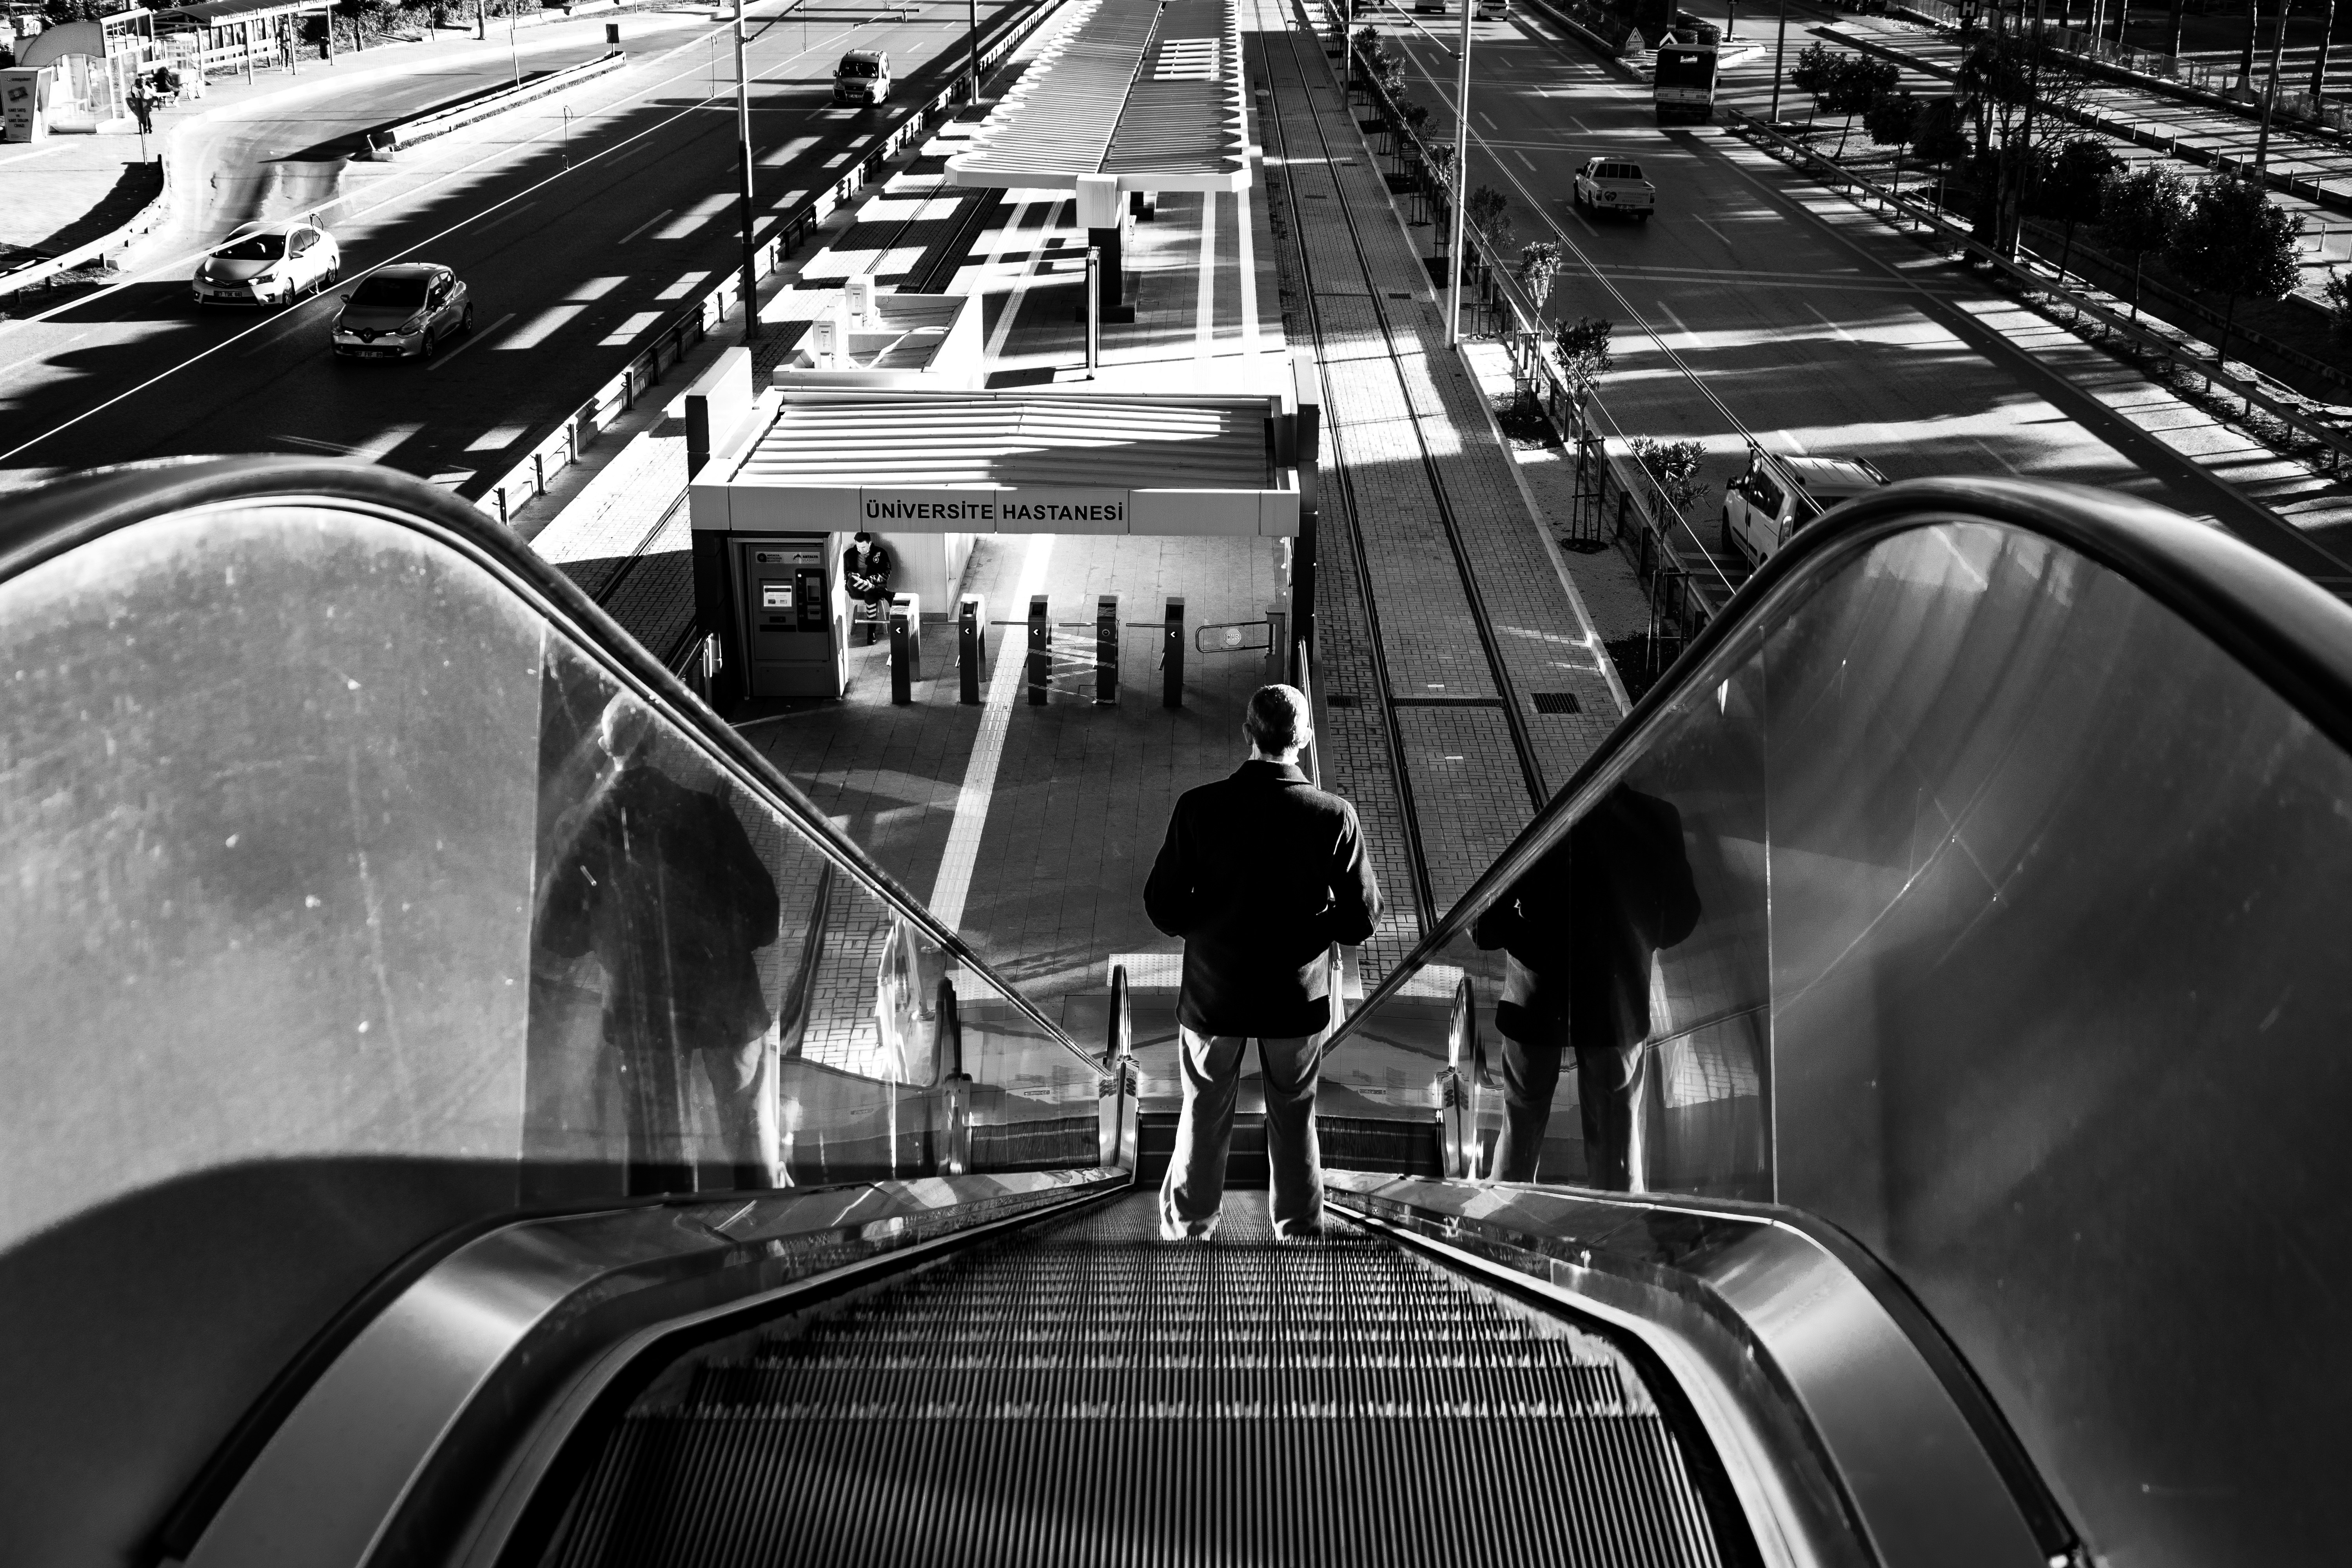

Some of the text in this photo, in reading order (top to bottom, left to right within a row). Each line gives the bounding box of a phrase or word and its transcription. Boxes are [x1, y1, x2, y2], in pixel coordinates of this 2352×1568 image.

[1962, 1, 1975, 16] H
[866, 499, 1122, 520] ÜNİVERSİTE HASTANESİ
